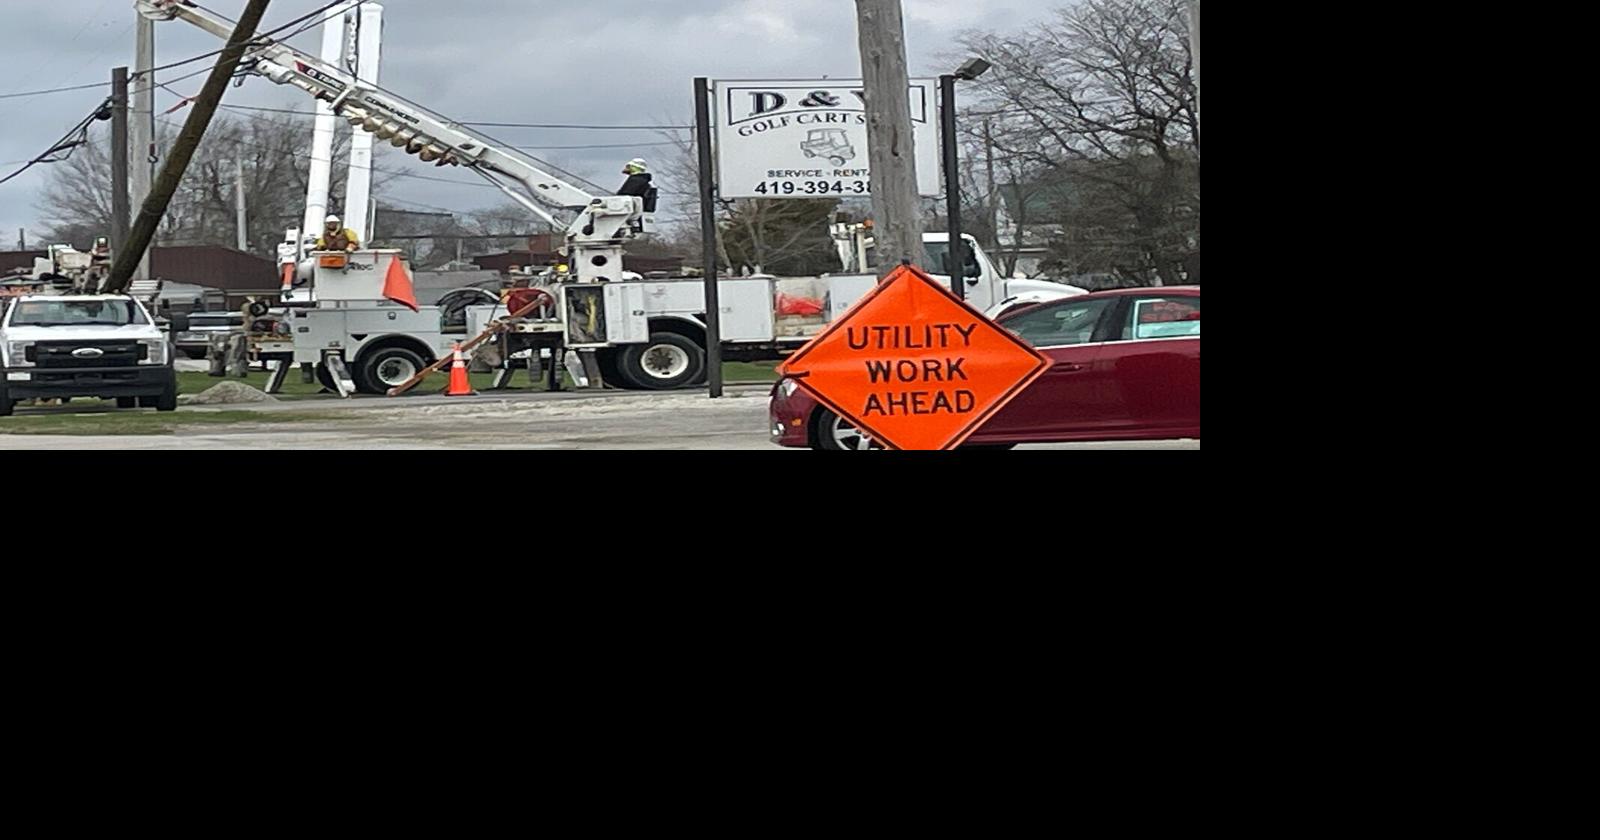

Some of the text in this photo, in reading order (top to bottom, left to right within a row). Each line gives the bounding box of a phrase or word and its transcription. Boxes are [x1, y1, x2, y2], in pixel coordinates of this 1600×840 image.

[748, 91, 787, 116] D
[798, 90, 841, 107] &
[738, 115, 792, 137] GOLF
[796, 113, 850, 125] CART
[767, 169, 823, 178] SERVICE
[833, 168, 871, 177] RENT
[847, 323, 978, 350] UTILITY
[865, 357, 968, 384] WORK
[862, 390, 976, 417] AHEAD
